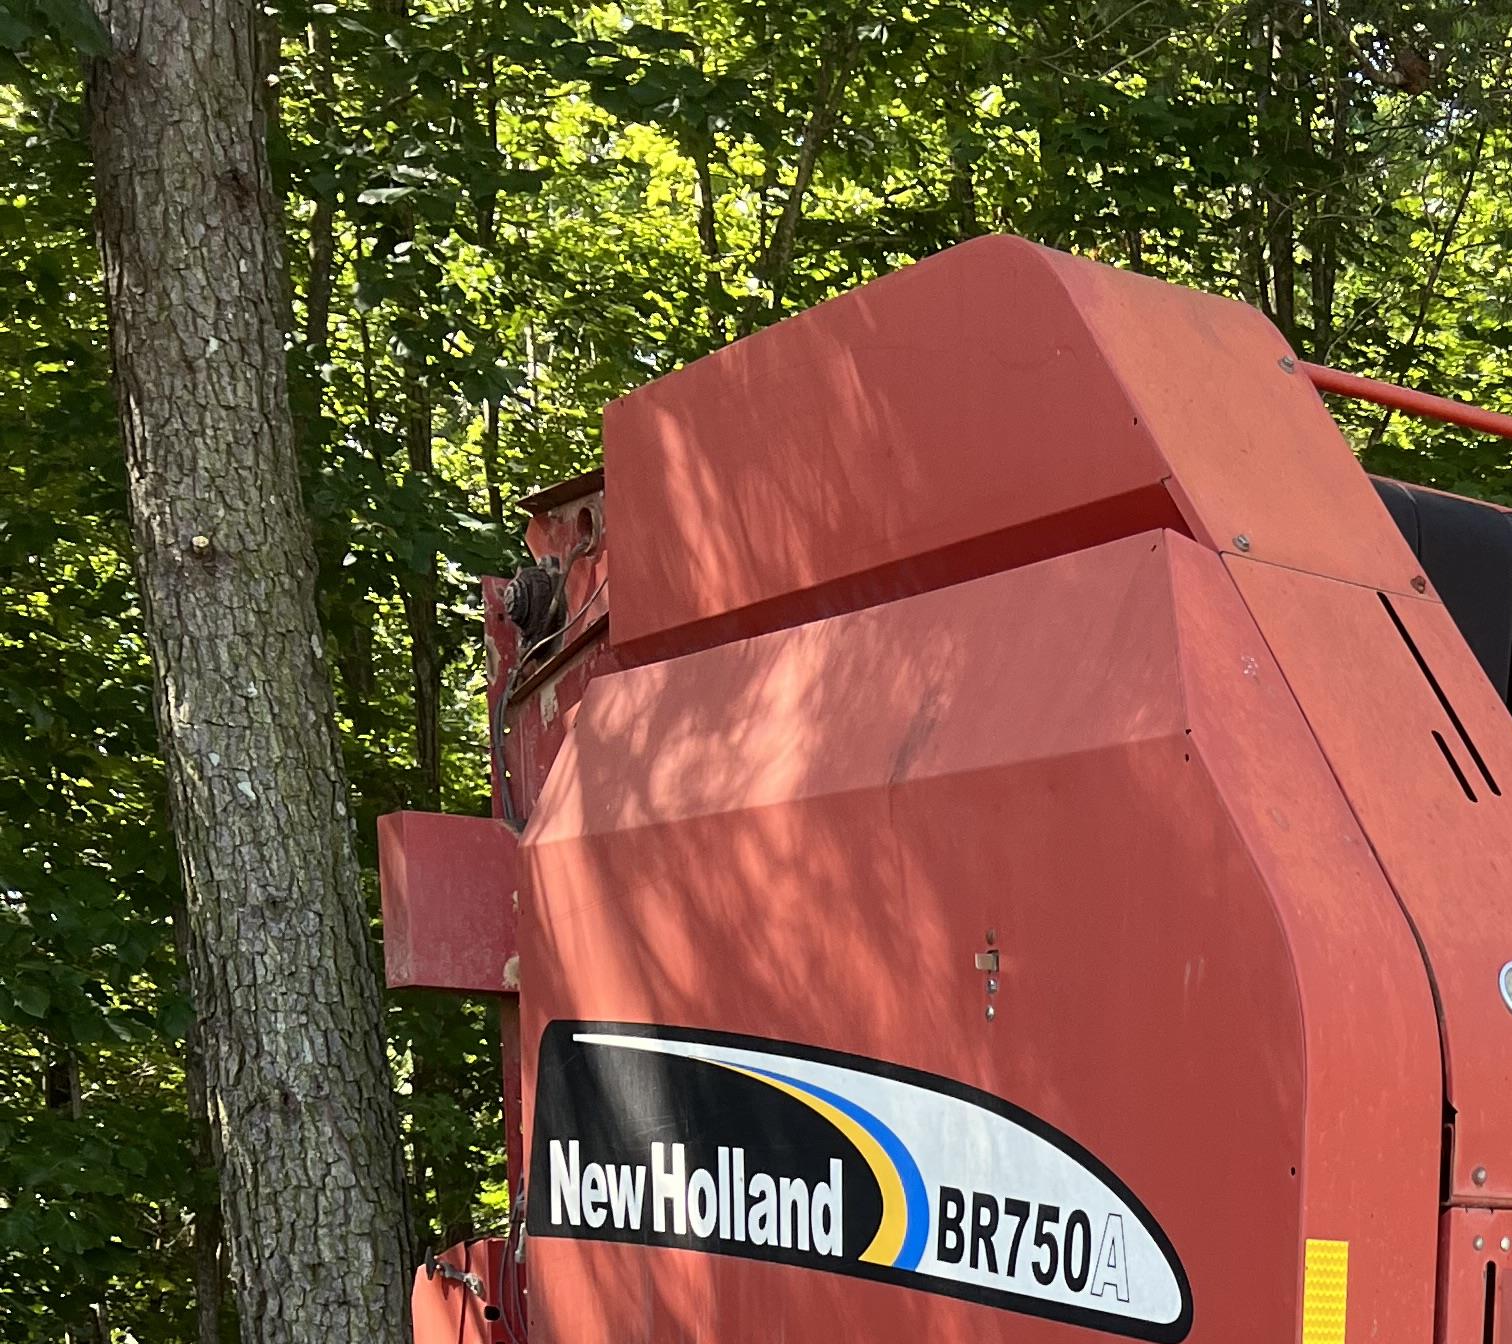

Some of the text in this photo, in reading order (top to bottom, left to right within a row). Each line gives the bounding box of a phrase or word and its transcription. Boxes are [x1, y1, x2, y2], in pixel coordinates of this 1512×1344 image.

[549, 1139, 843, 1258] New Holland
[936, 1185, 1130, 1303] BR750A
